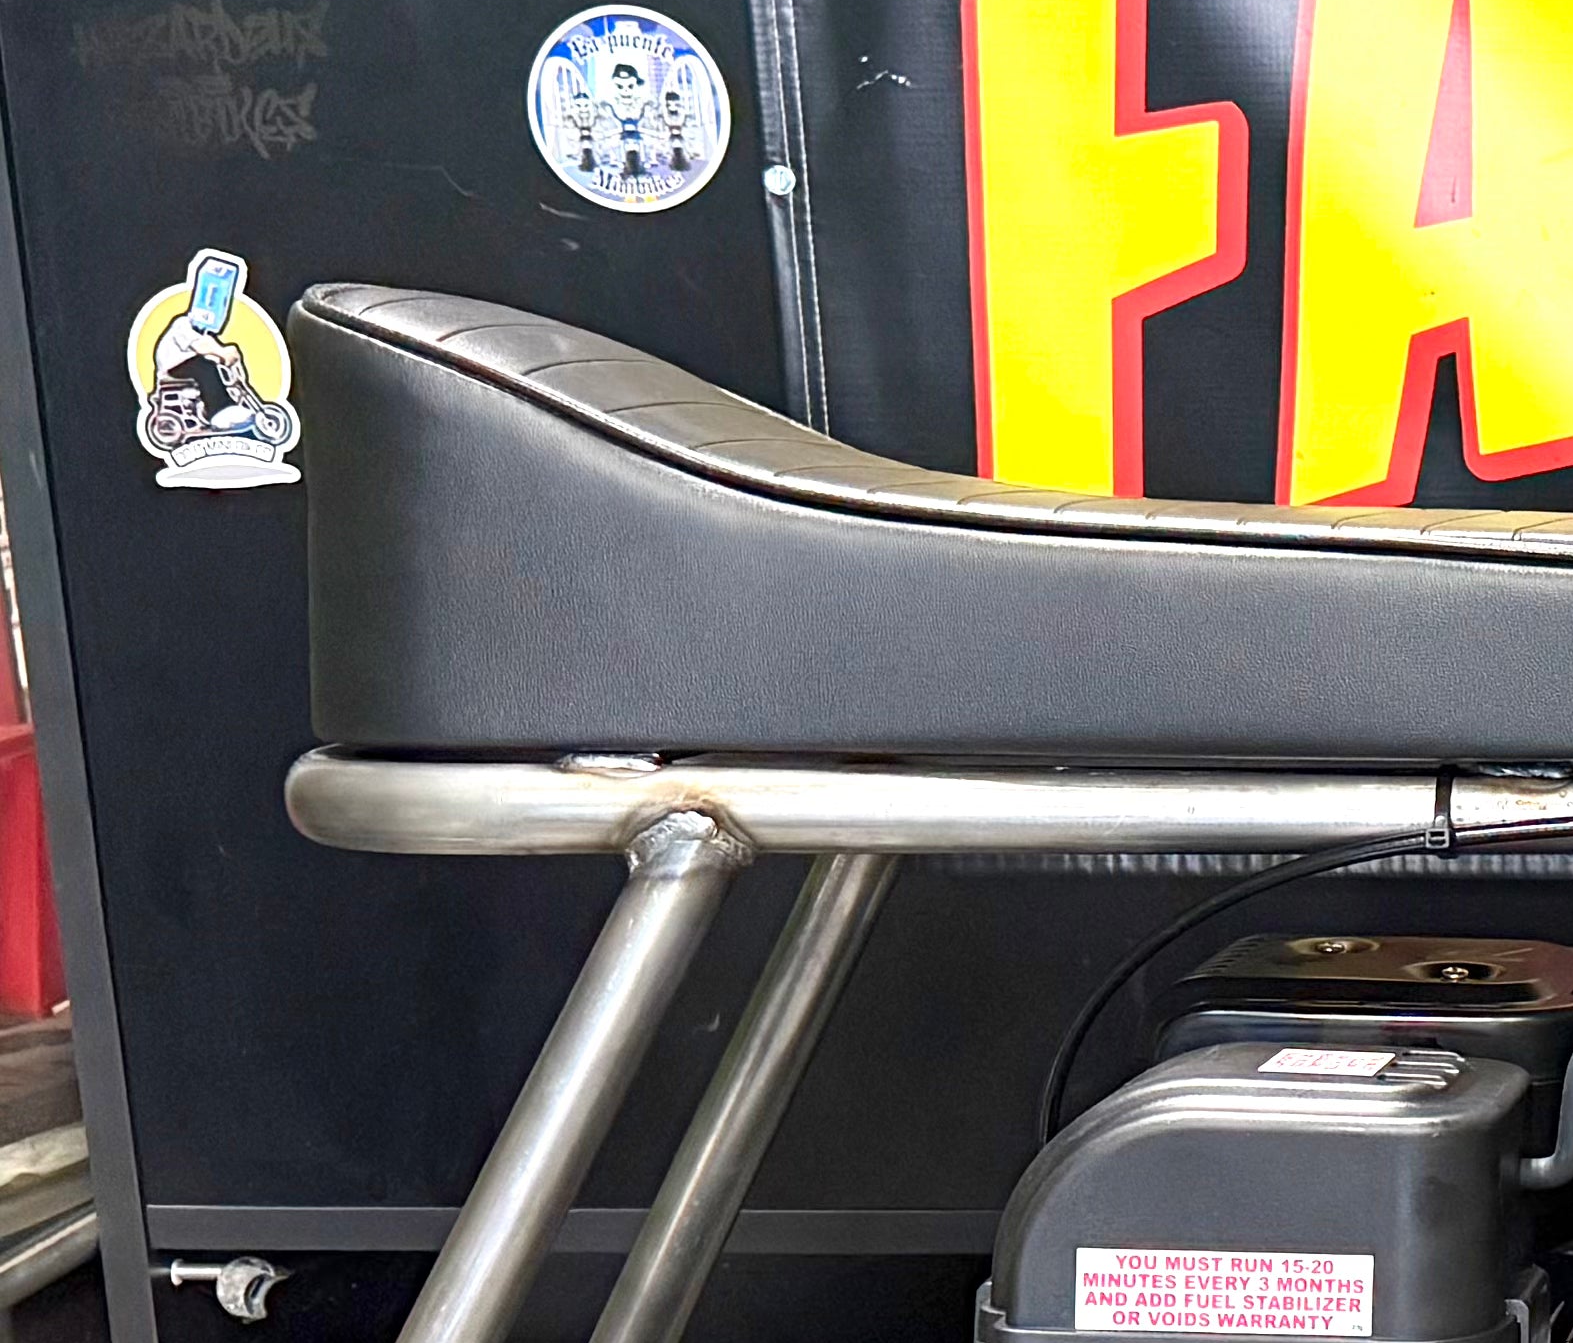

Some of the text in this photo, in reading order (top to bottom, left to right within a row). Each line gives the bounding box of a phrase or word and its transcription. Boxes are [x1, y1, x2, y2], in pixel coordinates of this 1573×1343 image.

[1116, 1255, 1333, 1275] YOU MUST RUN 15-20
[1083, 1273, 1363, 1294] MINUTES EVERY 3 MONTHS
[1085, 1292, 1361, 1313] AND ADD FUEL STABILIZER
[1112, 1311, 1333, 1330] OR VOIDS WARRANTY
